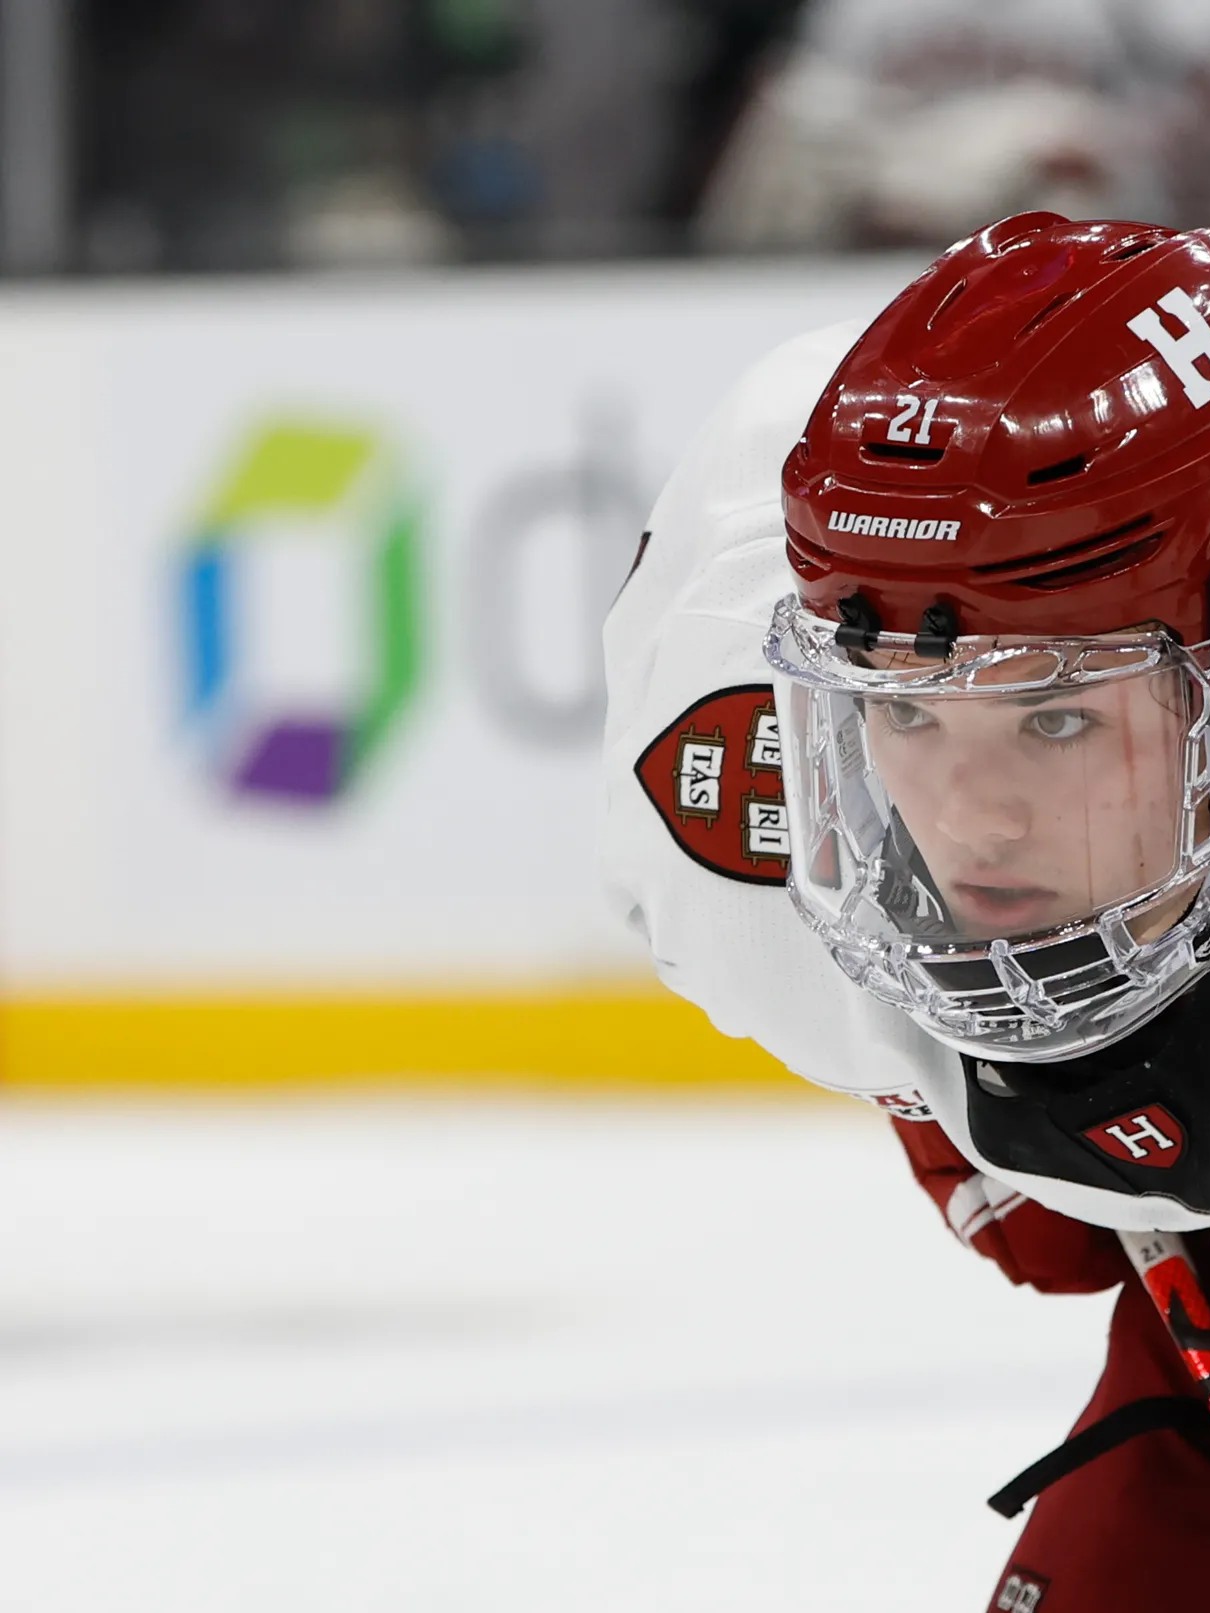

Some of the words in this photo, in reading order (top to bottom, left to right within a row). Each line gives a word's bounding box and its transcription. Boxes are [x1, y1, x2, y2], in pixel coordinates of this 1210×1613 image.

[886, 395, 939, 445] 21
[828, 510, 961, 541] WARRIOR
[688, 747, 714, 806] TAS
[759, 807, 782, 846] RI
[1104, 1114, 1175, 1160] H
